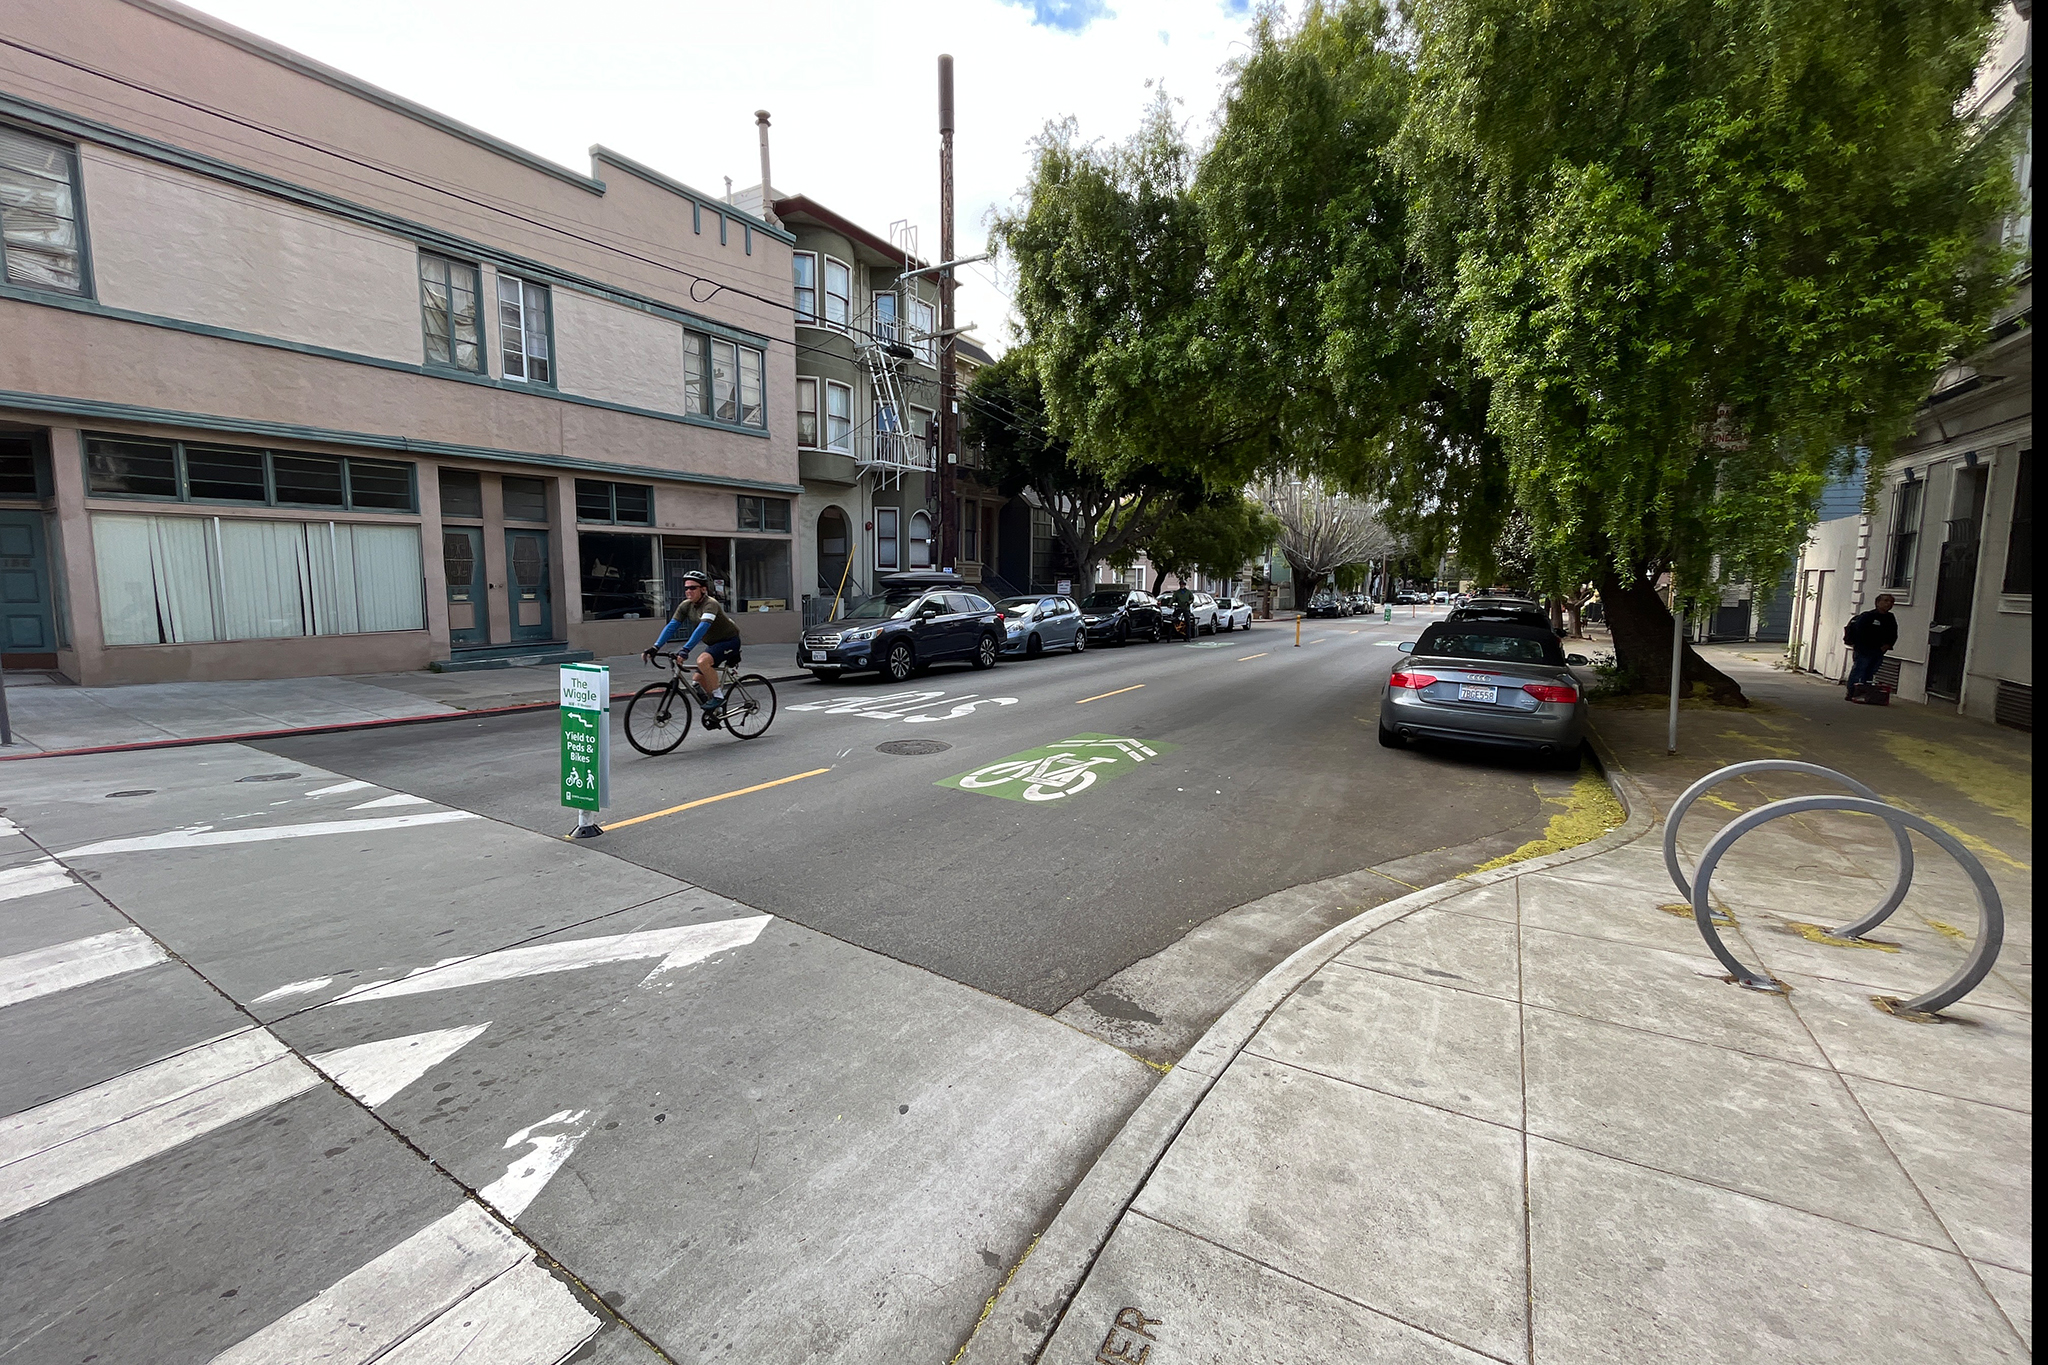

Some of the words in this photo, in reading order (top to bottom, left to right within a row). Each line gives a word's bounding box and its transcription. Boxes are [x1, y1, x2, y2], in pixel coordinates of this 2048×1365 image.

[571, 677, 588, 689] The
[563, 687, 597, 703] Wiggle
[1461, 689, 1494, 700] 7BGE558
[565, 731, 585, 742] Yield
[585, 733, 596, 744] to
[567, 741, 585, 752] Peds
[586, 743, 594, 753] &
[570, 751, 590, 764] Bikes
[1095, 1307, 1163, 1365] ER
